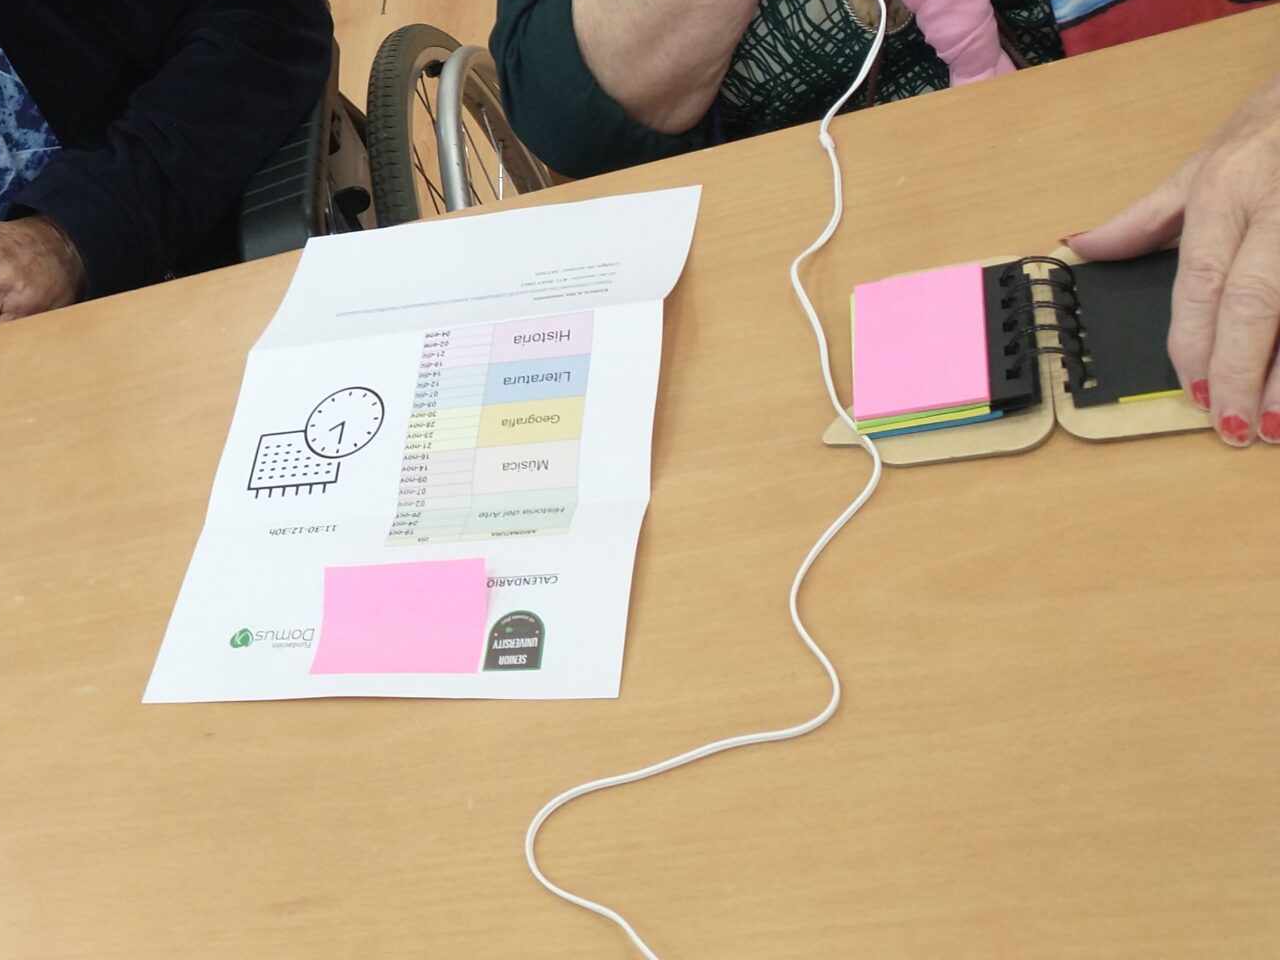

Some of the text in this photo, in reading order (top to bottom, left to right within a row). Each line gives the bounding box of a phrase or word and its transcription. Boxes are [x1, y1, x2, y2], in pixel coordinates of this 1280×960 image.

[513, 329, 571, 346] Historia
[503, 371, 571, 387] Literatura
[501, 414, 560, 428] Geografía
[502, 459, 549, 472] Música
[487, 576, 558, 588] CALENDARIO
[492, 638, 538, 650] UNIVERSITY
[498, 654, 528, 665] SENIOR
